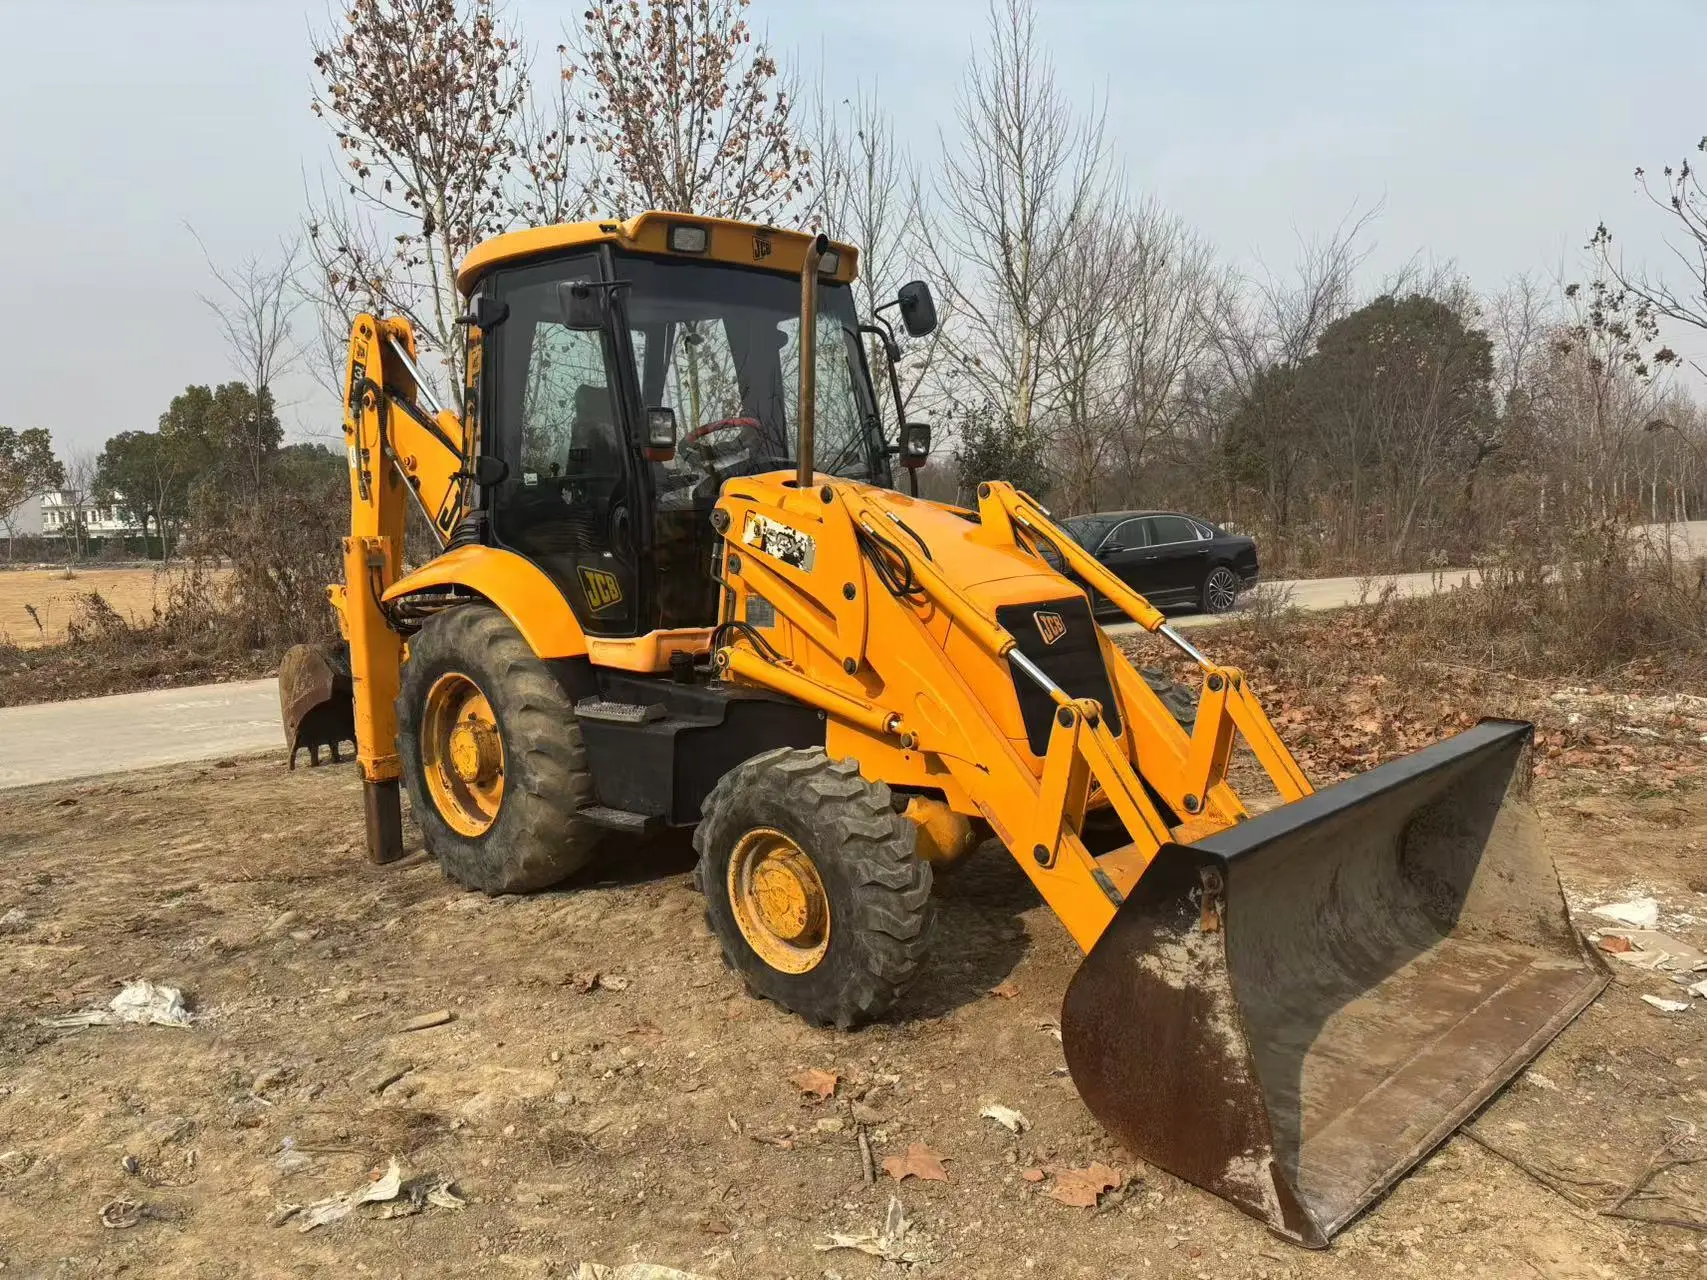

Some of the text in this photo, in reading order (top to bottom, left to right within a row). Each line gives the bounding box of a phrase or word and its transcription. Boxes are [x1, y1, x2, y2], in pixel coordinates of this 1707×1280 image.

[754, 239, 772, 259] JCB
[584, 570, 619, 607] JCB
[1039, 615, 1064, 641] JCB
